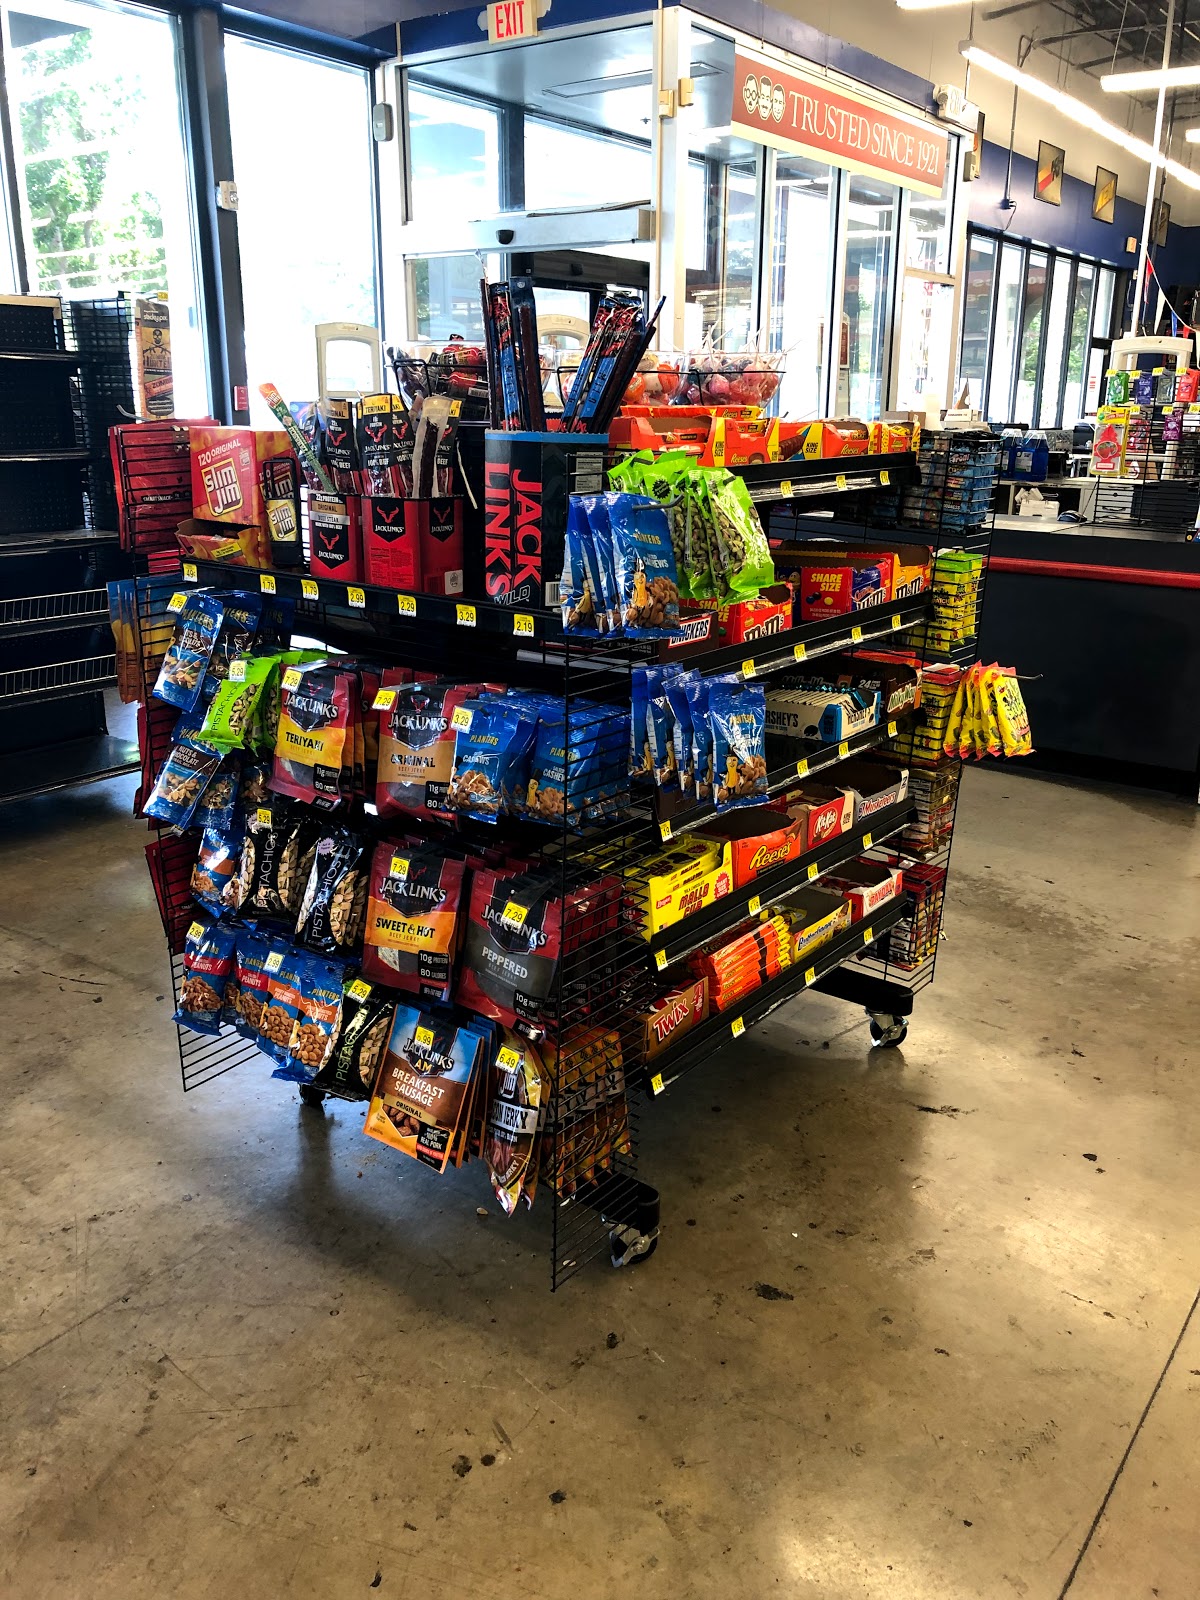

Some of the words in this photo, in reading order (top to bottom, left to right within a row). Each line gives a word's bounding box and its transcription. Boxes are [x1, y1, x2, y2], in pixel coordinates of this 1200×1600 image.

[496, 1, 525, 39] EXIT
[789, 91, 870, 150] TRUSTED
[872, 122, 914, 166] SINCE
[917, 140, 939, 176] 1921
[365, 405, 386, 414] TERIYAKI
[715, 441, 724, 449] KING
[806, 442, 818, 450] KING
[198, 451, 211, 466] 120
[210, 438, 241, 458] ORIGINAL
[317, 503, 338, 512] ORIGINAL
[374, 524, 388, 532] JACK
[388, 525, 404, 533] LINK'S
[485, 461, 513, 597] LINK'S
[511, 468, 543, 588] JACK
[318, 550, 330, 558] JACK
[810, 573, 843, 583] SHARE
[262, 580, 275, 592] 1.79
[304, 585, 318, 596] 1.79
[819, 582, 842, 592] SIZE
[350, 593, 364, 604] 2.99
[494, 585, 531, 606] WILD
[400, 601, 415, 613] 2.29
[459, 611, 474, 622] 3.29
[516, 621, 533, 633] 2.19
[231, 667, 244, 676] 5.29
[284, 675, 298, 687] 7.29
[858, 679, 872, 689] 24
[284, 692, 309, 712] JACK
[307, 699, 339, 718] LINK'S
[377, 696, 391, 707] 7.29
[388, 711, 417, 728] JACK
[416, 716, 448, 731] LINK'S
[454, 714, 469, 727] 3.29
[765, 711, 799, 728] RSHEY'S
[285, 731, 324, 752] TERIYAKI
[469, 734, 499, 746] PLANTERS
[390, 753, 436, 768] ORIGINAL
[549, 747, 578, 762] PLANERS
[315, 780, 324, 790] 80
[428, 783, 439, 794] 11g
[427, 800, 437, 809] 80
[863, 791, 897, 816] Musketeers
[258, 814, 270, 824] 5.29
[842, 811, 852, 820] KING
[392, 863, 407, 875] 7.29
[380, 877, 408, 895] JACK
[408, 882, 447, 902] LINK'S
[869, 882, 894, 908] PAYDAY
[311, 859, 342, 938] PISTACHIOS
[679, 883, 710, 911] MALLO
[505, 908, 523, 922] 7.29
[190, 927, 202, 938] 2.99
[375, 917, 408, 932] SWEET
[407, 924, 416, 935] &
[416, 925, 436, 939] HOT
[389, 931, 403, 939] BEEF
[403, 934, 420, 943] JERKY
[268, 957, 280, 968] 2.99
[419, 952, 433, 964] 10g
[481, 946, 529, 979] PEPPERED
[191, 961, 213, 971] PEANUTS
[419, 968, 431, 977] 80
[241, 975, 262, 987] PEANUTS
[311, 988, 340, 1000] PLANTERS
[350, 984, 368, 997] 5.29
[515, 992, 529, 1007] 10g
[403, 1038, 427, 1058] JACK
[424, 1049, 455, 1070] LINK'S
[413, 1058, 433, 1073] AM
[499, 1053, 516, 1069] 6.49
[391, 1067, 445, 1099] BREAKFAST
[394, 1080, 434, 1107] SAUSAGE
[395, 1100, 423, 1119] ORIGINAL
[504, 1106, 529, 1130] JERKY
[429, 1140, 443, 1150] PORK
